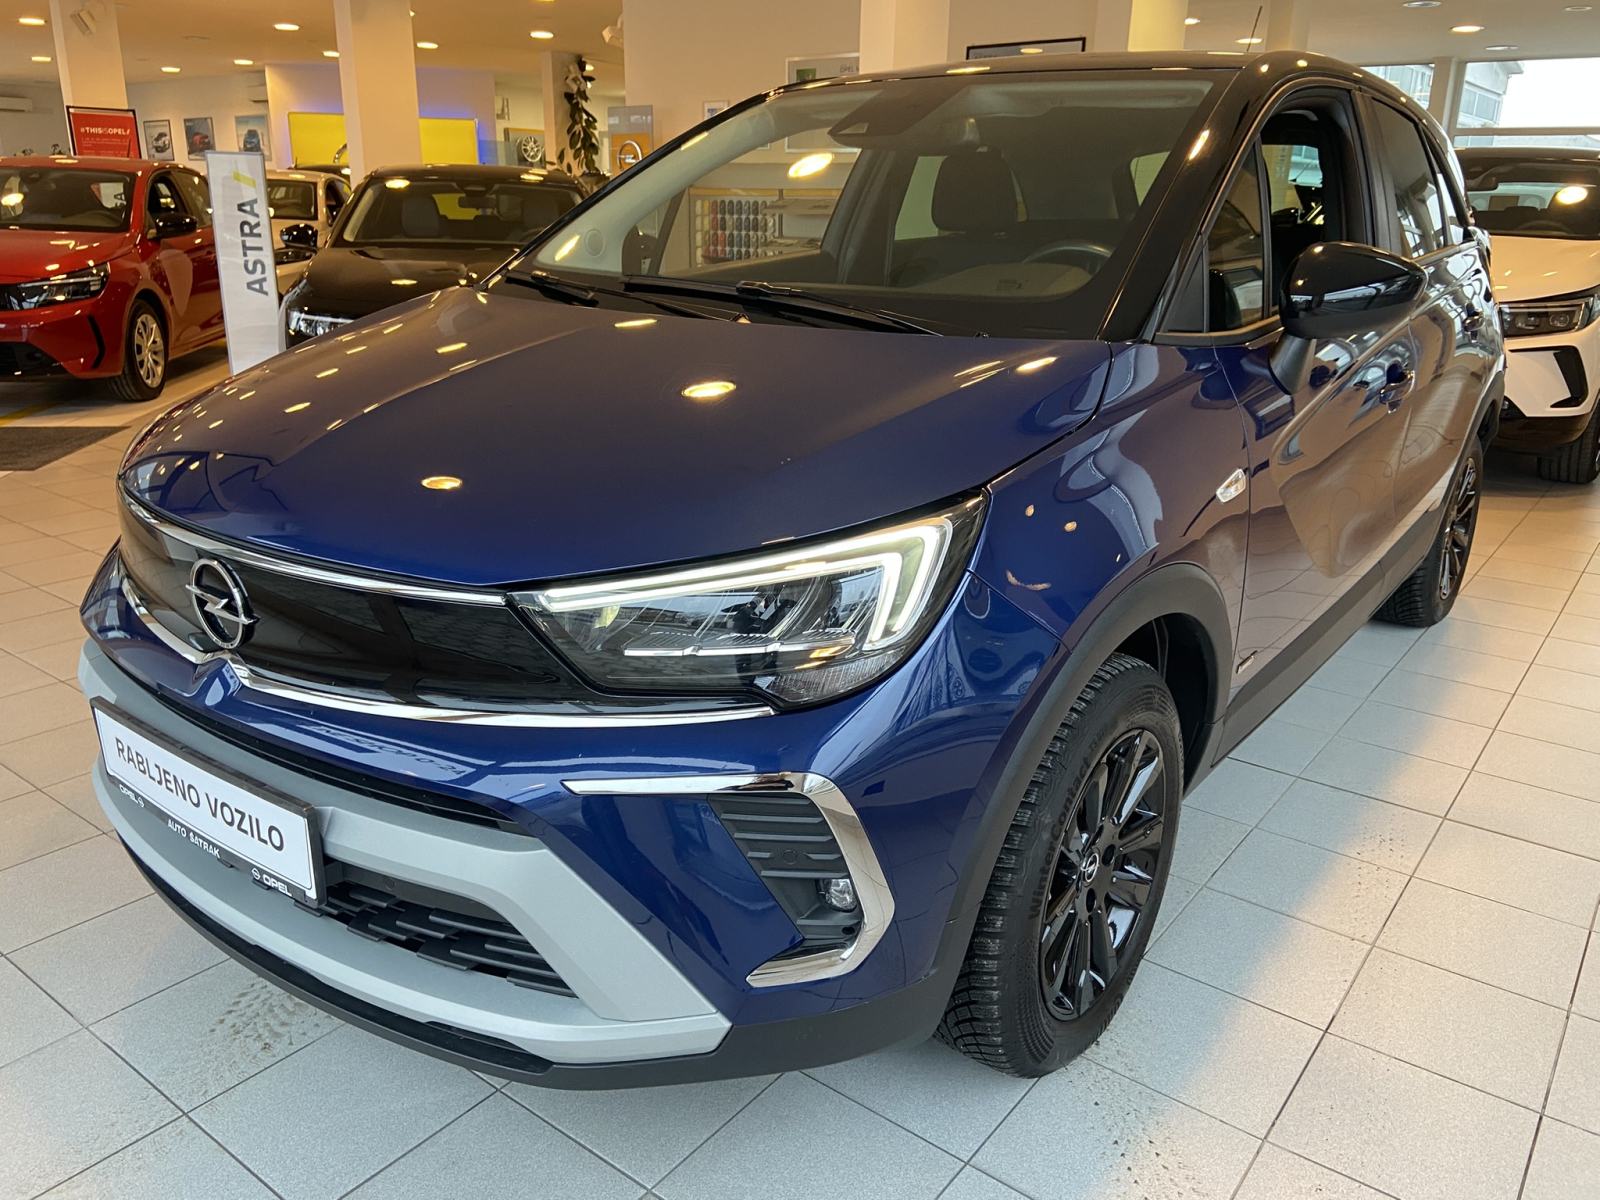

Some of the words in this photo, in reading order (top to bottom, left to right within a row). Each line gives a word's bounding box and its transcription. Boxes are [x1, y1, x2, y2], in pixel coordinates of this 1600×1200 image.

[237, 198, 268, 296] ASTRA
[115, 737, 200, 808] RABLJENO
[205, 792, 284, 851] VOZILO
[119, 784, 139, 804] OPEL
[167, 819, 187, 838] AUTO
[262, 873, 292, 897] OPEL
